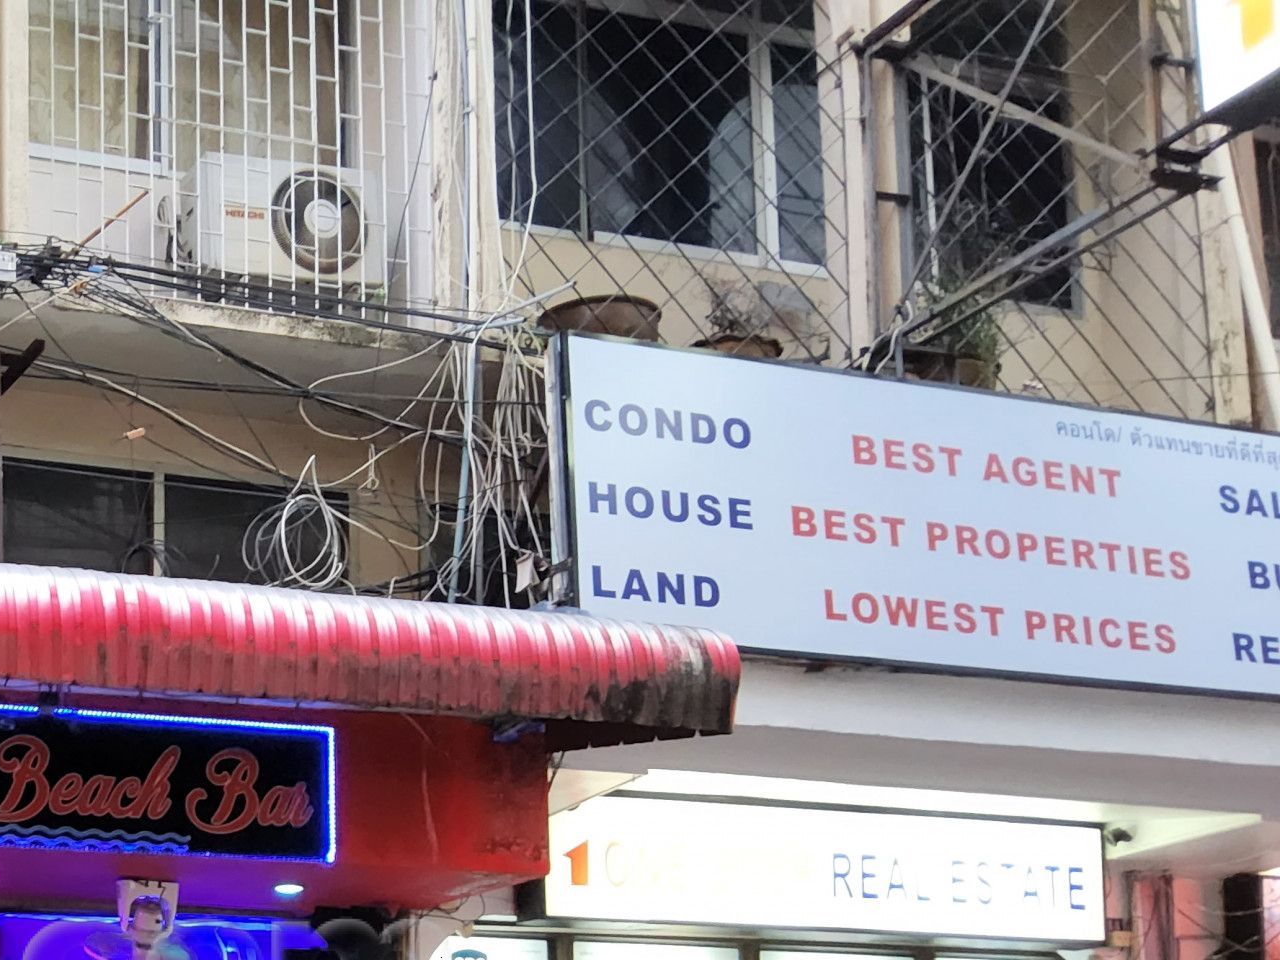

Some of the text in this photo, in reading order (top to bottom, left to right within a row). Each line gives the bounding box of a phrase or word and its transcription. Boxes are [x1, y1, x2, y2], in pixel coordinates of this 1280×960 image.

[584, 399, 752, 449] CONDO
[1130, 426, 1280, 471] ตัวแทนขายที่ดีที่สุ
[851, 434, 1122, 498] BEST AGENT
[588, 481, 754, 531] HOUSE
[791, 505, 1192, 581] BEST PROPERTIES
[591, 565, 721, 608] LAND
[823, 589, 1178, 654] LOWEST PRICES
[185, 747, 315, 835] Bar
